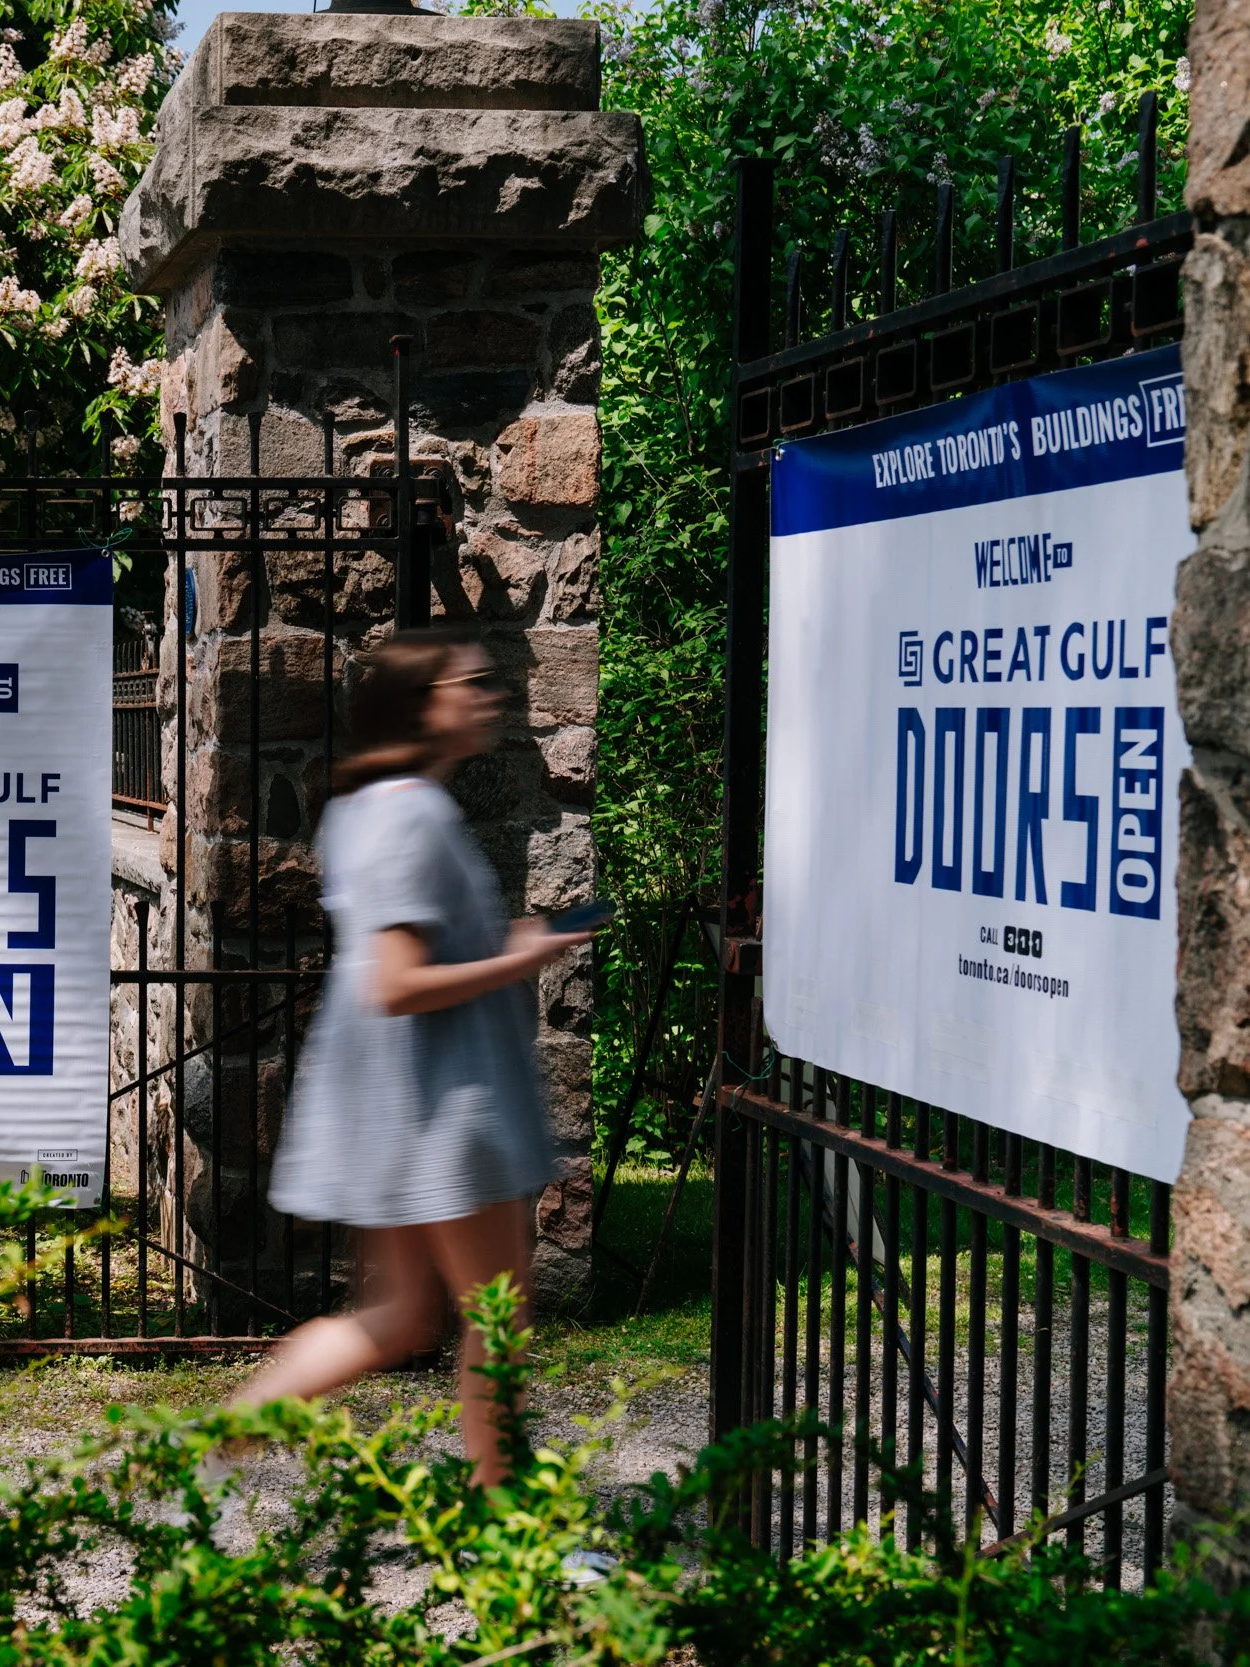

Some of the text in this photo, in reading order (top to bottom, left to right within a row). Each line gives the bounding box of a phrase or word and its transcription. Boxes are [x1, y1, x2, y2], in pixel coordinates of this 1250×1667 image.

[872, 384, 1186, 489] EXPLORE TORONTO'S BUILDINGS FR
[29, 567, 67, 586] FREE
[974, 533, 1068, 589] WELCOME TO
[933, 617, 1167, 684] GREAT GULF
[894, 707, 1158, 913] DOORS OPEN
[980, 926, 998, 945] CALL
[958, 954, 1069, 999] toronto.ca/doorsopen
